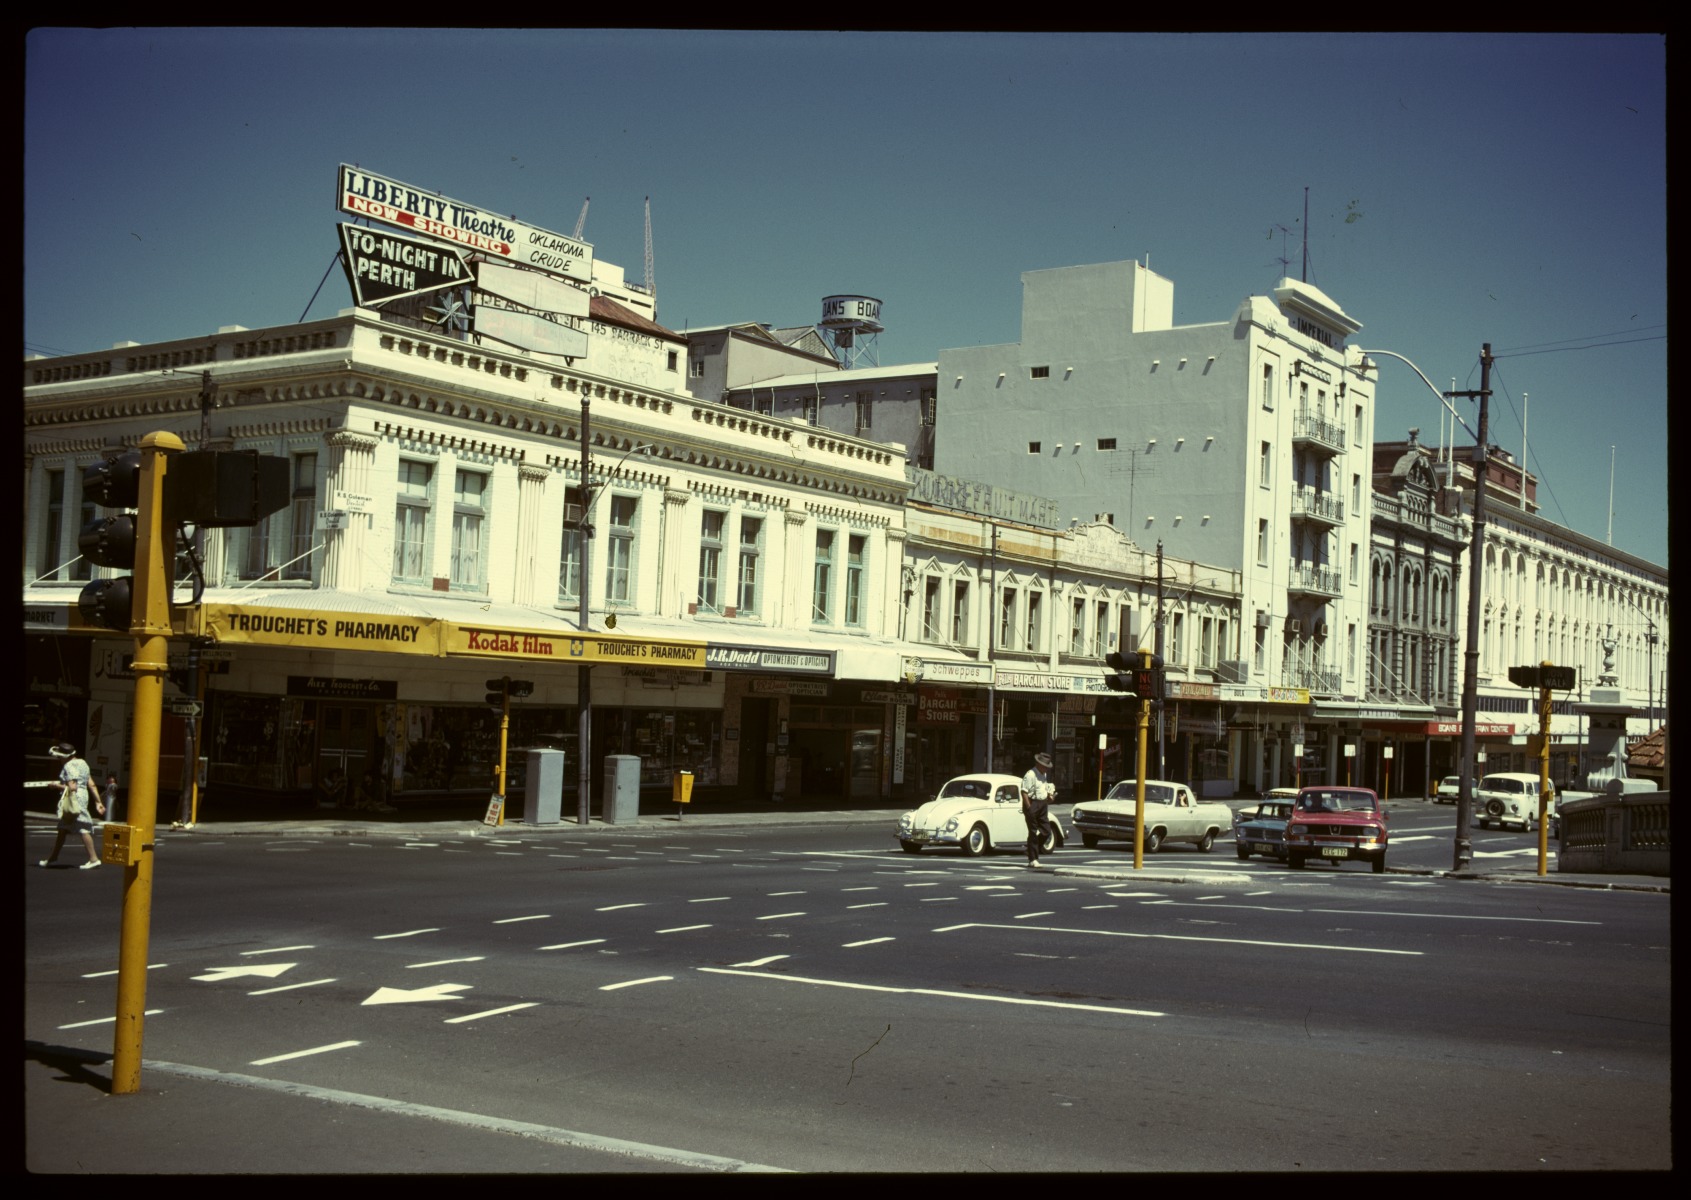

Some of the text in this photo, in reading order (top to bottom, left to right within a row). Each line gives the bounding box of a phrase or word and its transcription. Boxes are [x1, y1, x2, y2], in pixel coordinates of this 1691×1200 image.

[346, 171, 516, 244] LIBERTY Theatre
[353, 199, 502, 255] NOW SHOWING
[350, 229, 461, 279] TO-NIGHT IN
[528, 231, 585, 259] OKLAHOMA
[529, 250, 572, 272] CRUDE
[357, 258, 416, 290] PERTH
[590, 322, 607, 336] 145
[1297, 317, 1333, 349] IMPERIAL
[228, 613, 419, 643] TROUCHET'S PHARMACY
[467, 629, 553, 655] Kodak film
[597, 642, 698, 661] TROUCHET'S PHARMACY
[763, 653, 799, 666] OPTOMETRIST
[804, 656, 827, 667] OPTICIAN
[932, 664, 980, 680] Schweppes
[1013, 674, 1044, 688] BARGAIN
[1047, 675, 1071, 690] STORE
[926, 709, 956, 721] STORE
[1490, 724, 1509, 734] CENTRE
